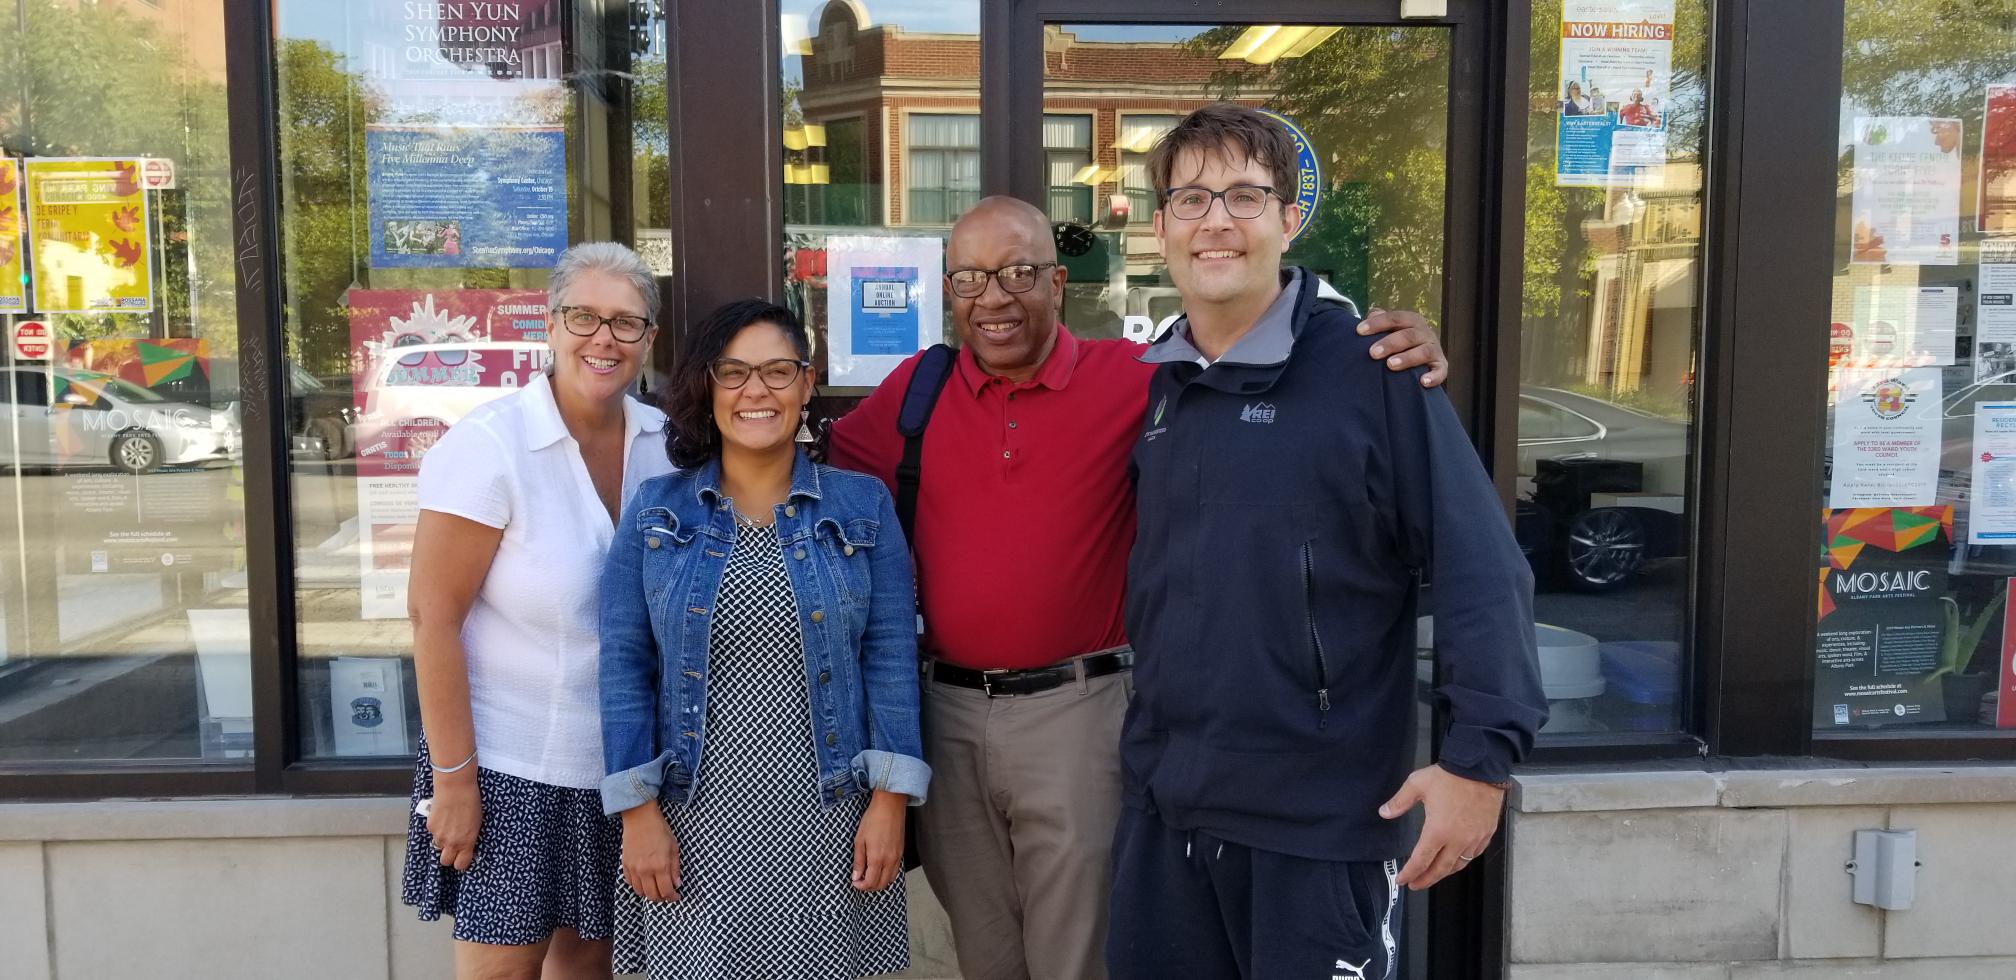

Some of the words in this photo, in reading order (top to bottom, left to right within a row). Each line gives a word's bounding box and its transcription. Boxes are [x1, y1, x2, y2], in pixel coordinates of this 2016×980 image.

[403, 1, 463, 21] SHEN
[469, 1, 519, 21] YUN
[405, 25, 520, 42] SYMPHONY
[1571, 23, 1608, 37] NOW
[1612, 24, 1665, 38] HIRING
[405, 47, 521, 65] ORCHESTRA
[382, 142, 410, 152] Music
[414, 142, 434, 152] That
[436, 142, 461, 152] Runs
[382, 153, 401, 164] Five
[450, 154, 475, 165] Deep
[497, 177, 520, 185] Symphony
[36, 205, 46, 216] DE
[48, 204, 70, 216] GRIPE
[72, 204, 78, 215] Y
[497, 305, 547, 315] SUMMER
[512, 319, 545, 330] COMID
[82, 408, 192, 431] MOSAIC
[1252, 409, 1276, 419] REI
[360, 441, 389, 458] GRATIS
[1836, 570, 1930, 594] MOSAIC
